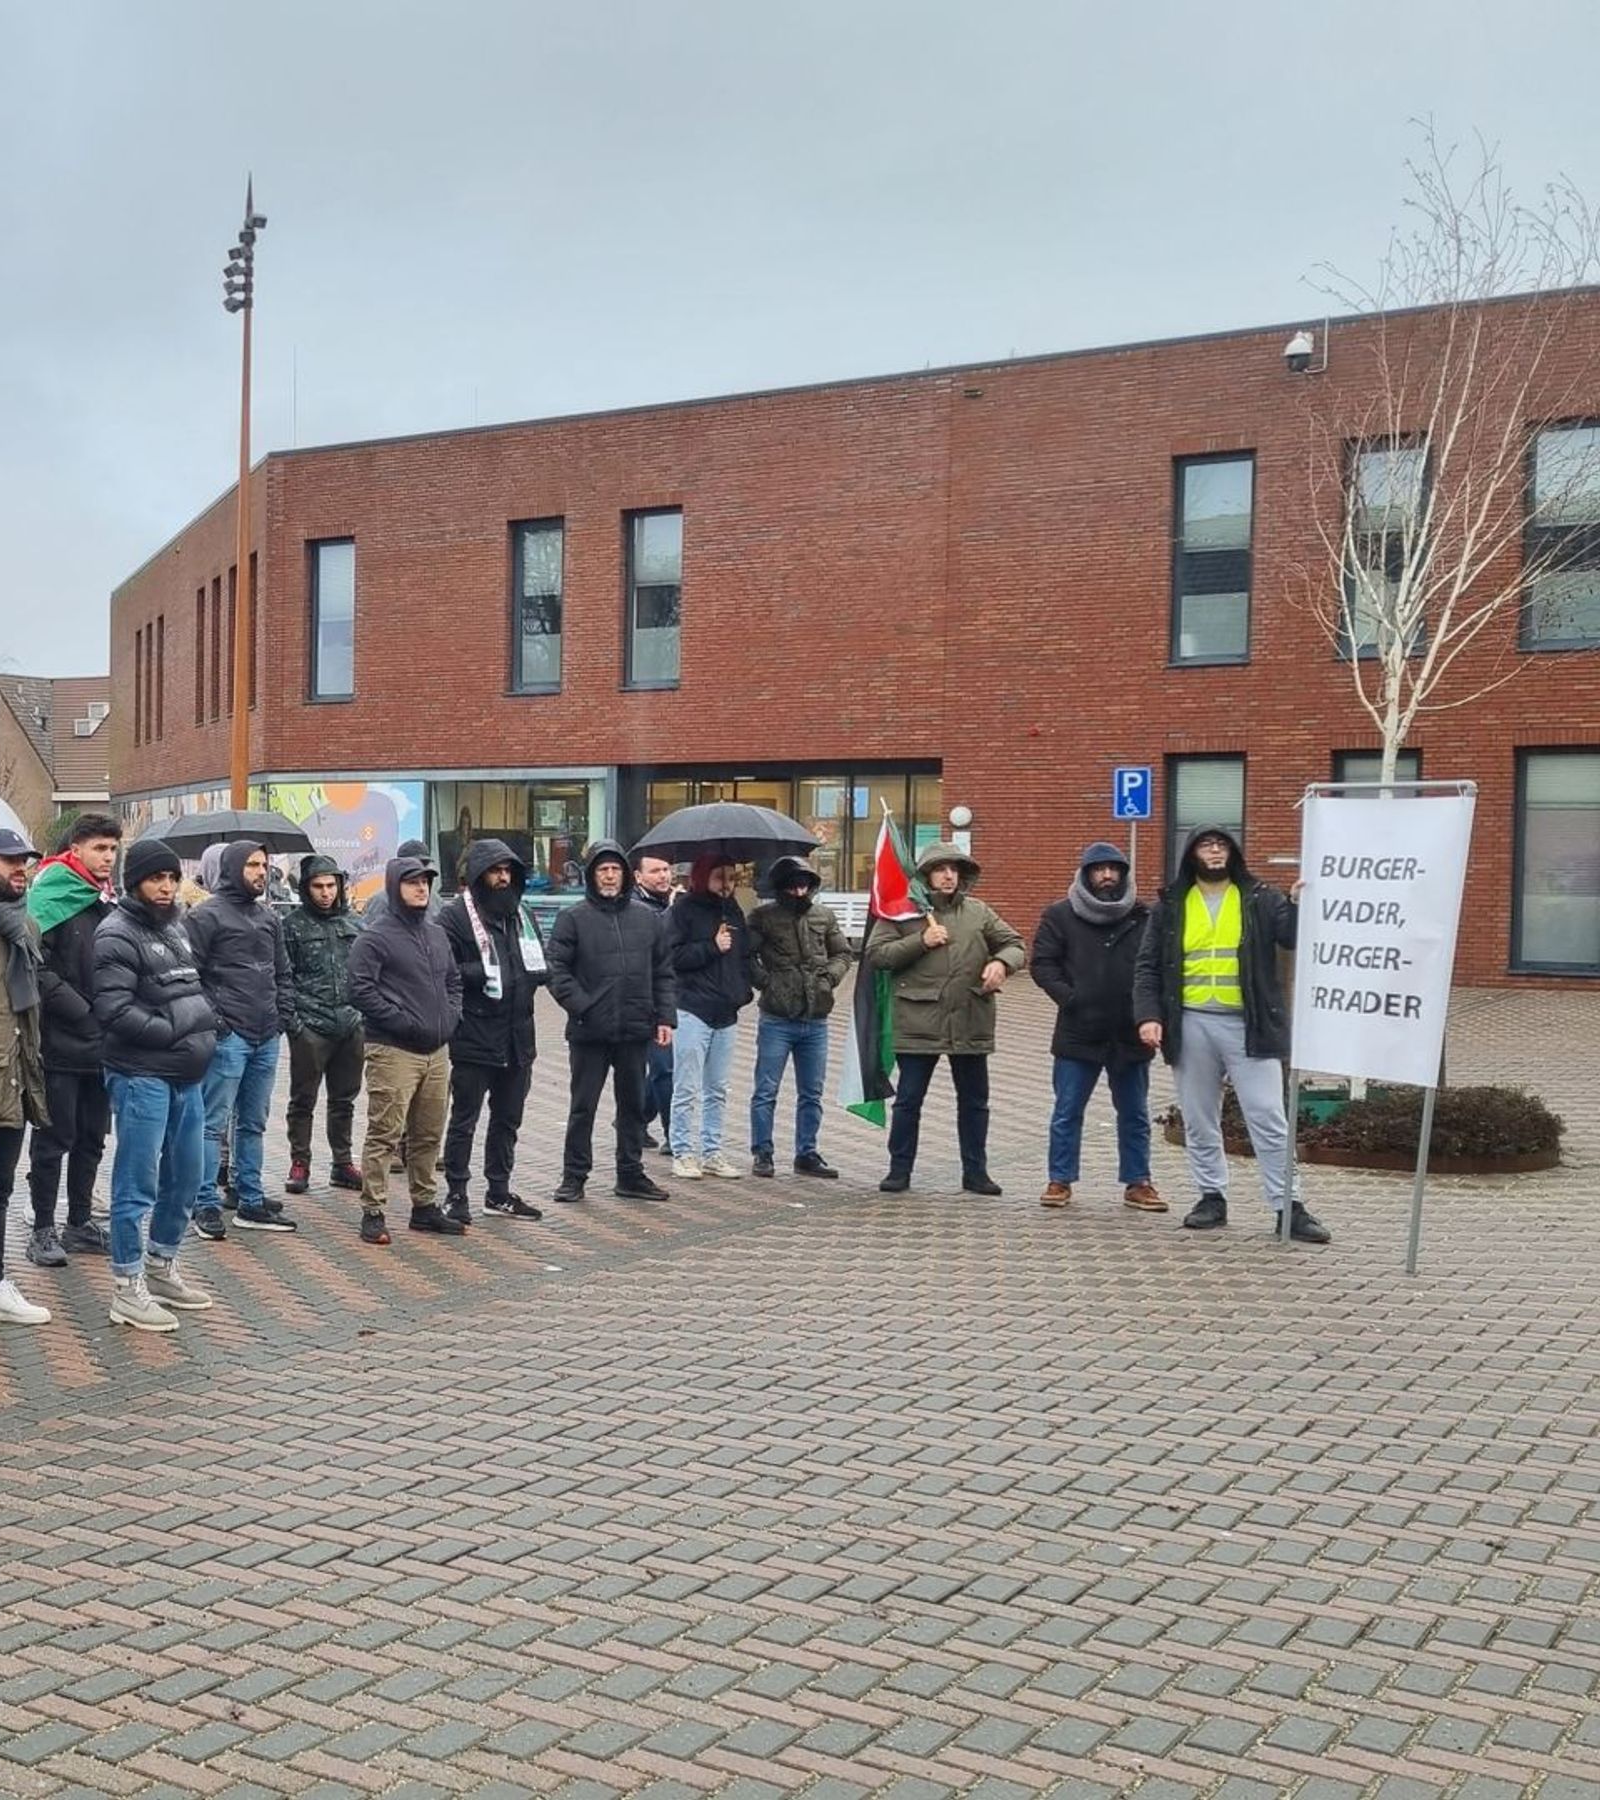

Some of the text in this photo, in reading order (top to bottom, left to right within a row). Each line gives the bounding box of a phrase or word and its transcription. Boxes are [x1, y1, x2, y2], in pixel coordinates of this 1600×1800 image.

[1123, 772, 1143, 797] P
[1320, 855, 1426, 881] BURGER-
[1321, 899, 1406, 929] VADER,
[1312, 986, 1422, 1019] RRADER
